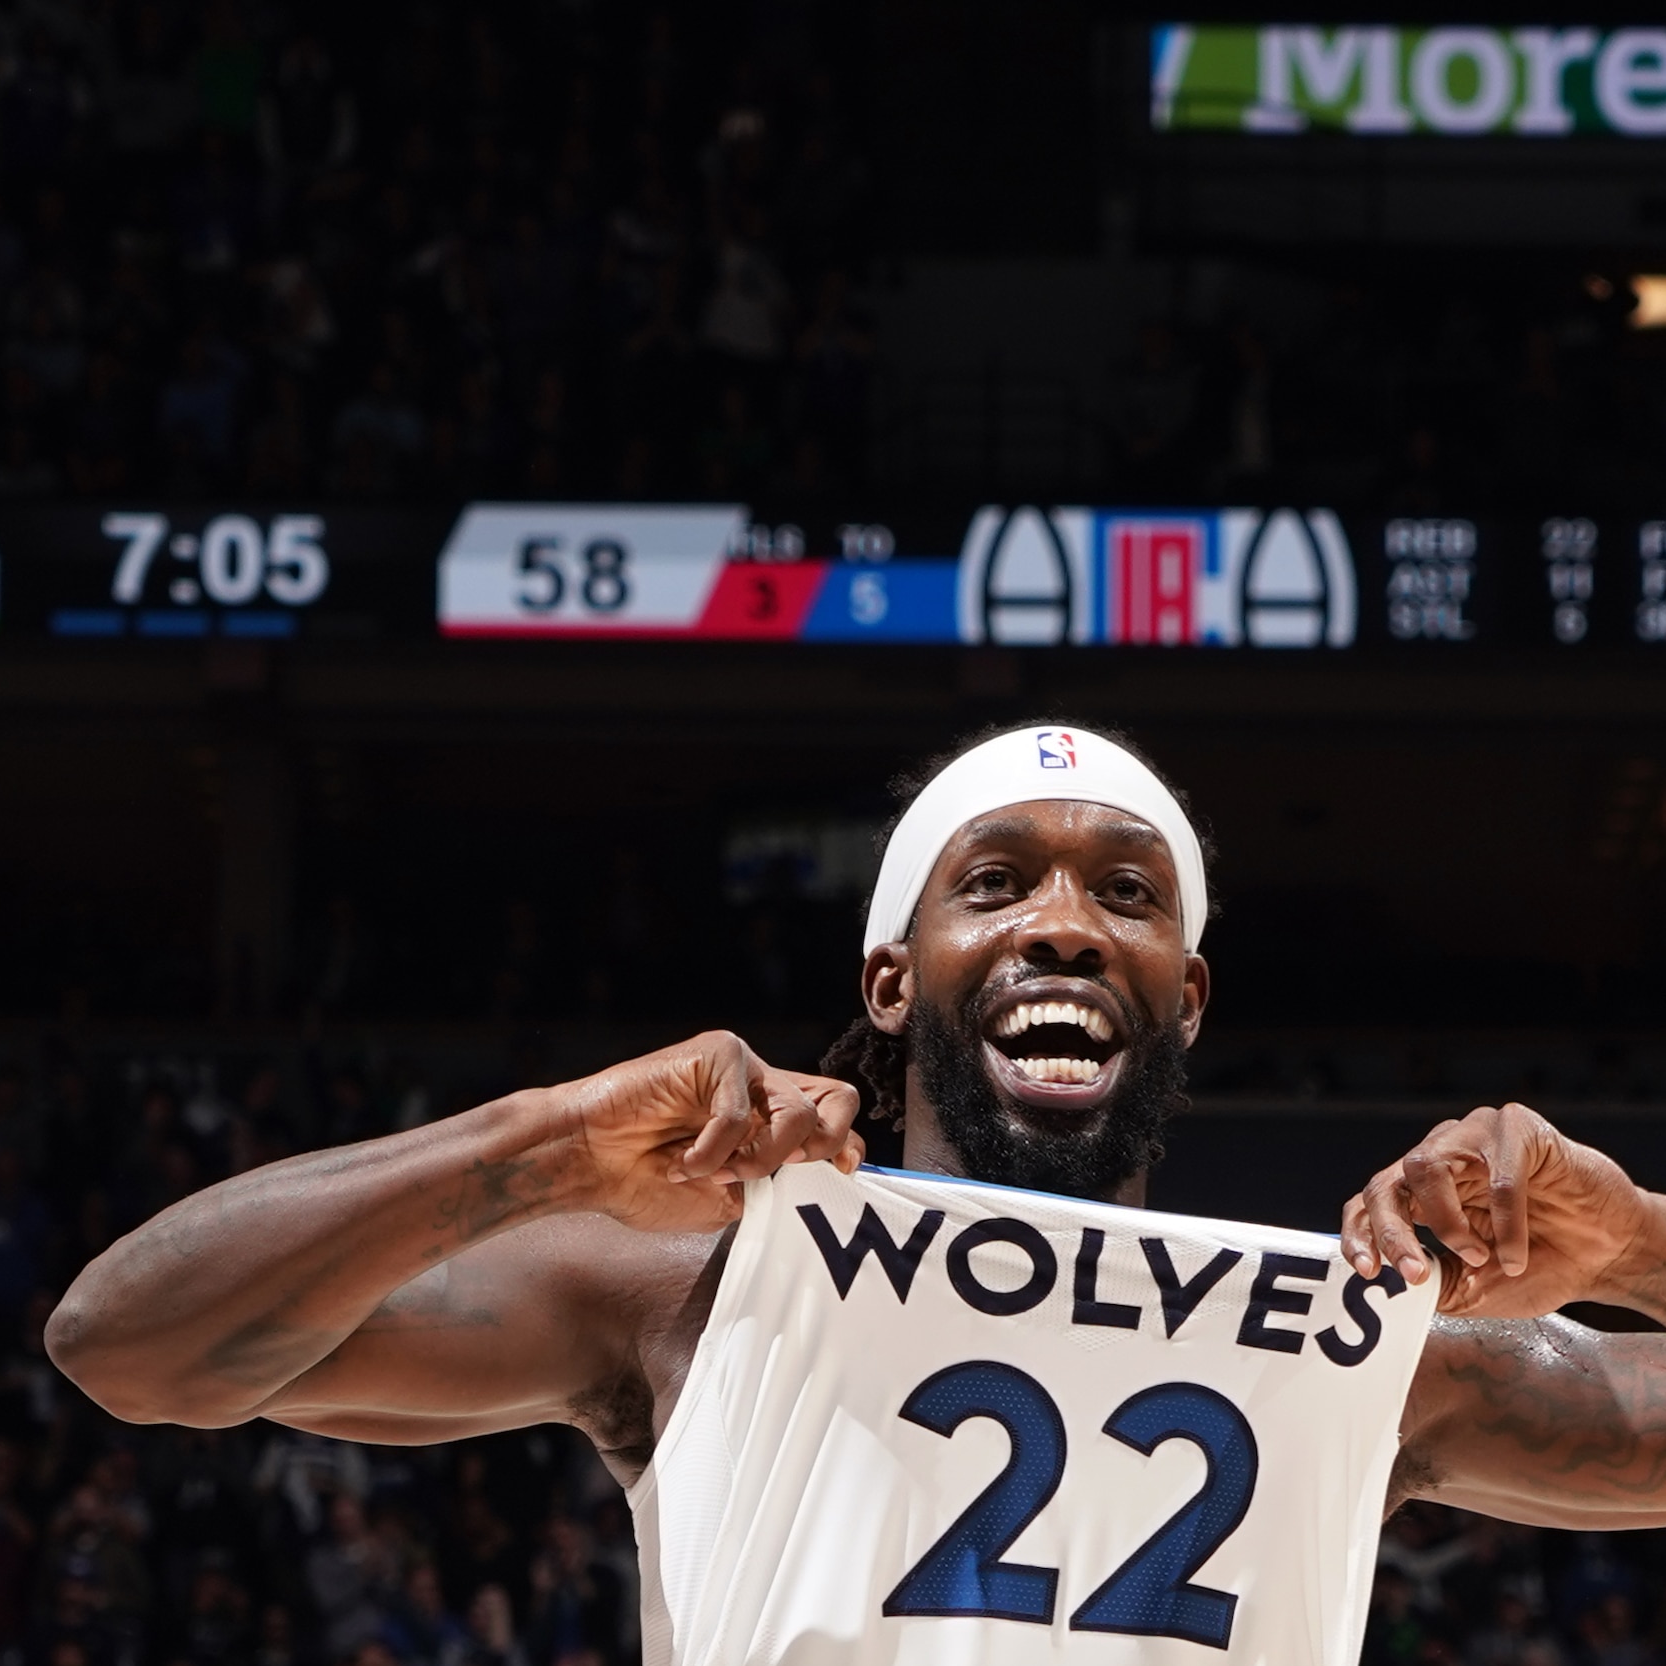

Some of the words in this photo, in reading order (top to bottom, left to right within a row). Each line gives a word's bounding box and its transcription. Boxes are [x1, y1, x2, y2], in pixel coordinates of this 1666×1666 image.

[104, 514, 329, 604] 7:05
[513, 538, 631, 614] 58
[849, 571, 889, 627] 5
[796, 1202, 1408, 1368] WOLVES
[882, 1360, 1259, 1651] 22
